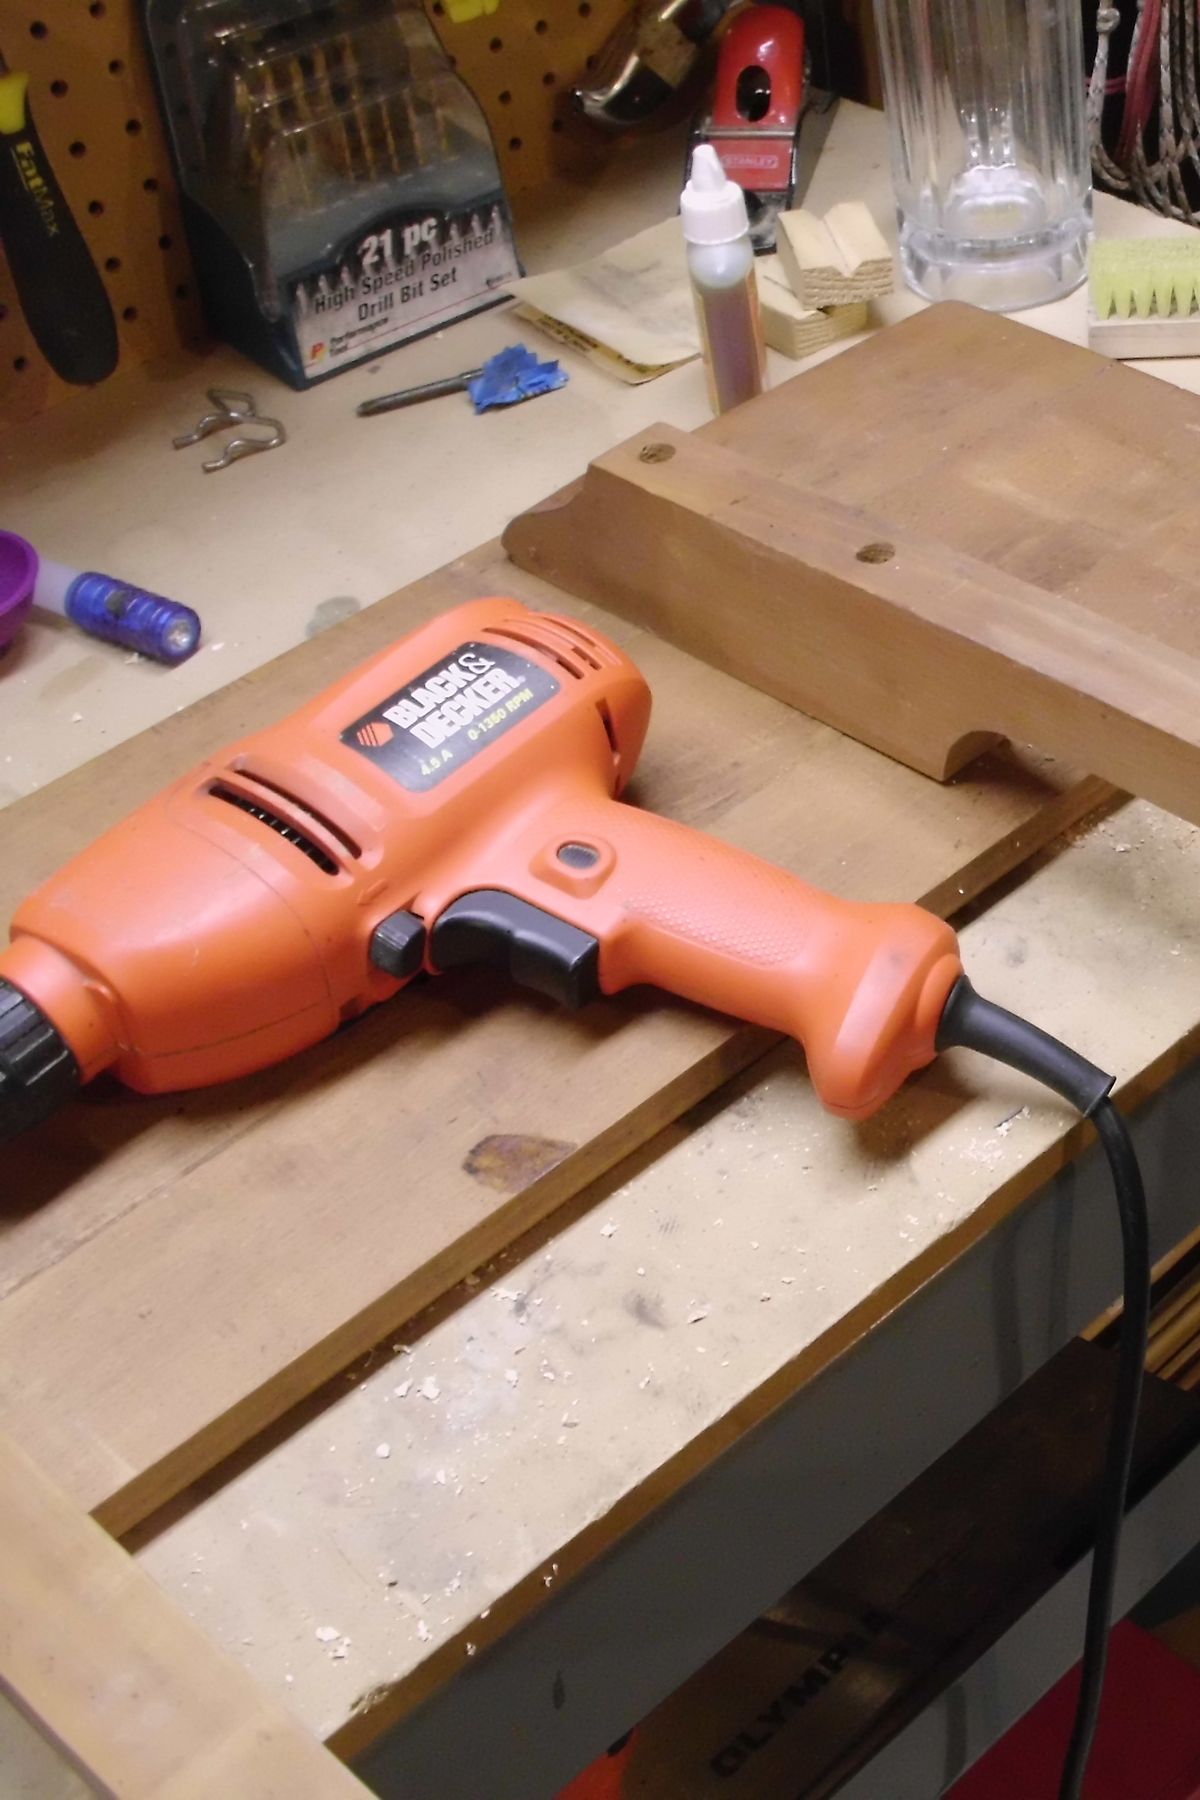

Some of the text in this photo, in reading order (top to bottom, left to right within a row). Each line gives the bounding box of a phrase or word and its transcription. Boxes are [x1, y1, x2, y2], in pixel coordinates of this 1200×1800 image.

[725, 156, 776, 167] STANLEY
[358, 217, 438, 266] 21 pc
[314, 228, 495, 315] High Speed Polished
[358, 292, 394, 321] Drill
[401, 280, 425, 303] Bit
[430, 267, 458, 291] Set
[382, 652, 496, 729] BLACK &
[410, 667, 520, 749] DECKER
[505, 688, 534, 713] RPM
